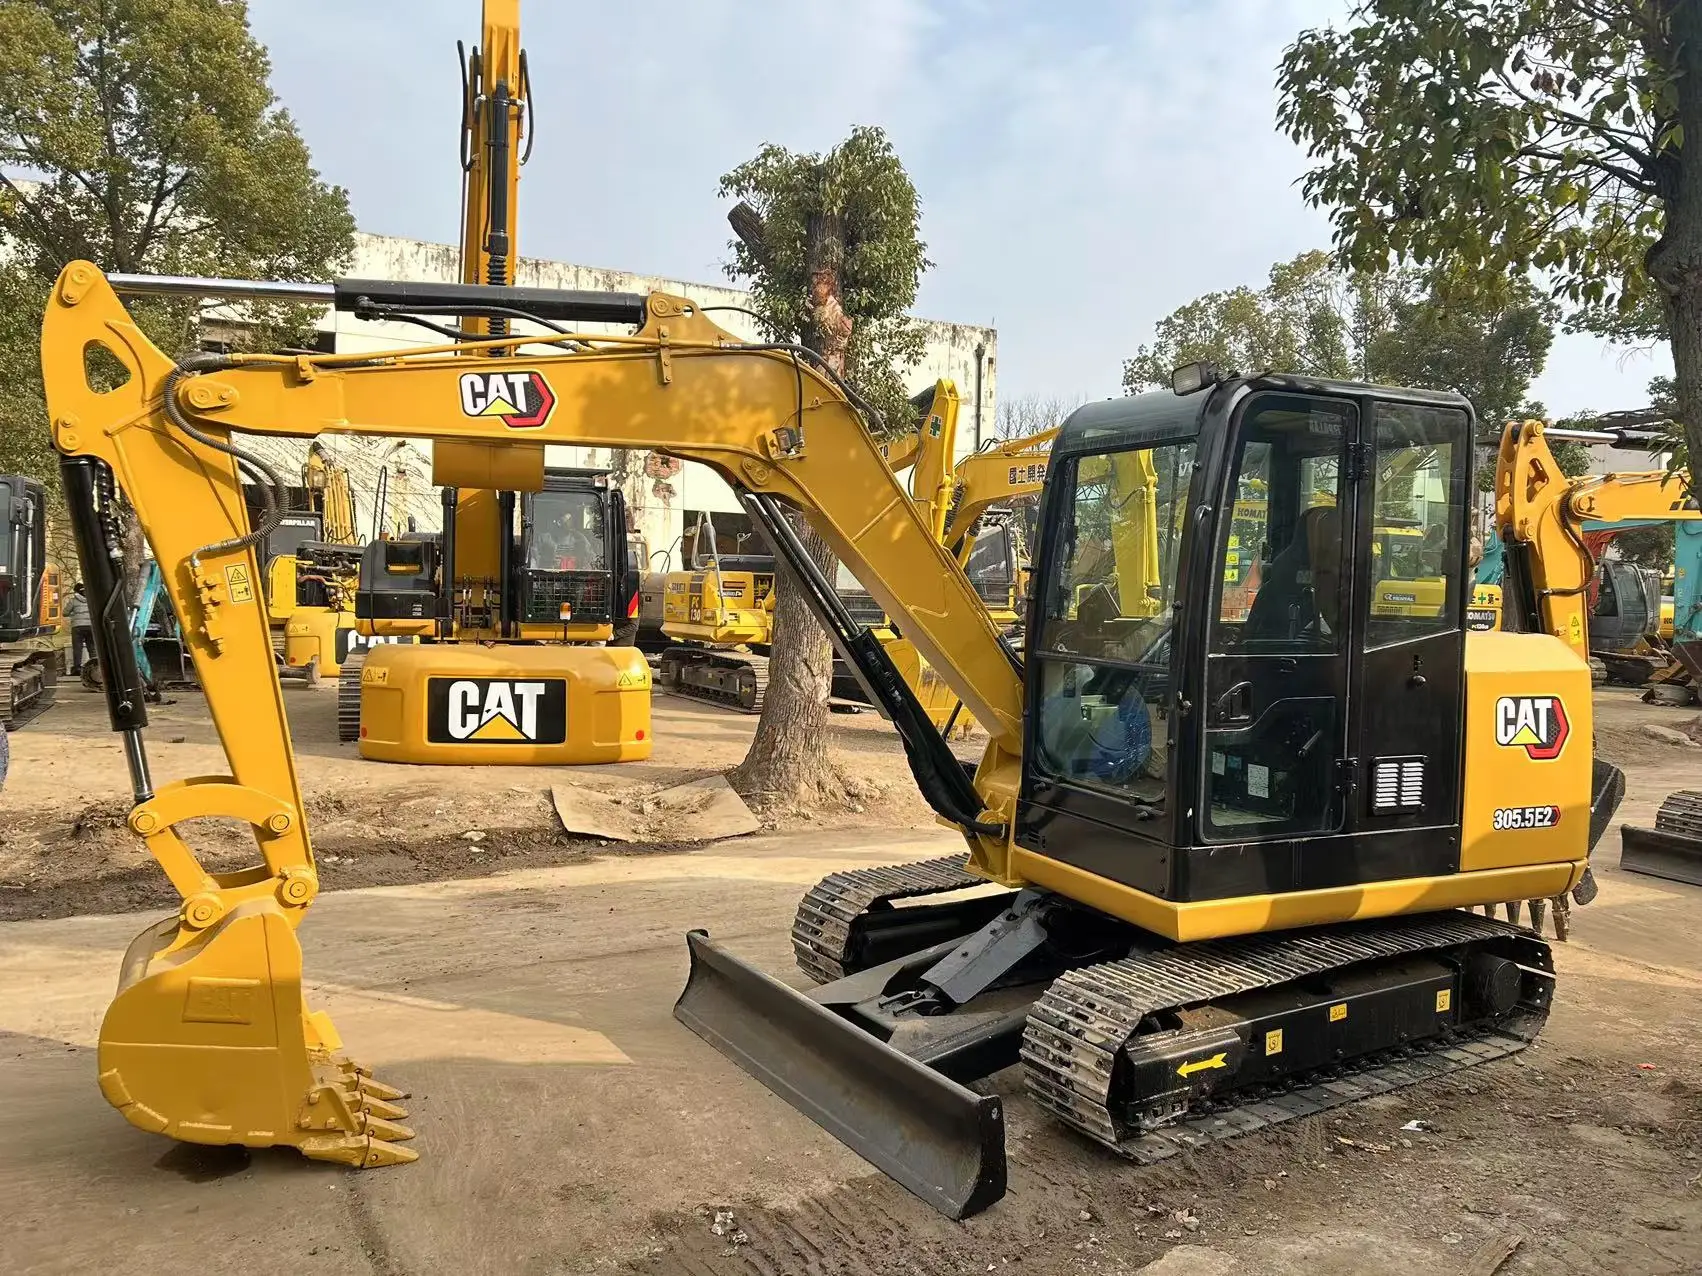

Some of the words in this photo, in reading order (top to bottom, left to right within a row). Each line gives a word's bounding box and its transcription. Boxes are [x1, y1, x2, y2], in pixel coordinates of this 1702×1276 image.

[460, 373, 530, 416] CAT
[448, 680, 546, 740] CAT
[1496, 697, 1552, 745] CAT
[1493, 806, 1552, 830] 305.5E2
